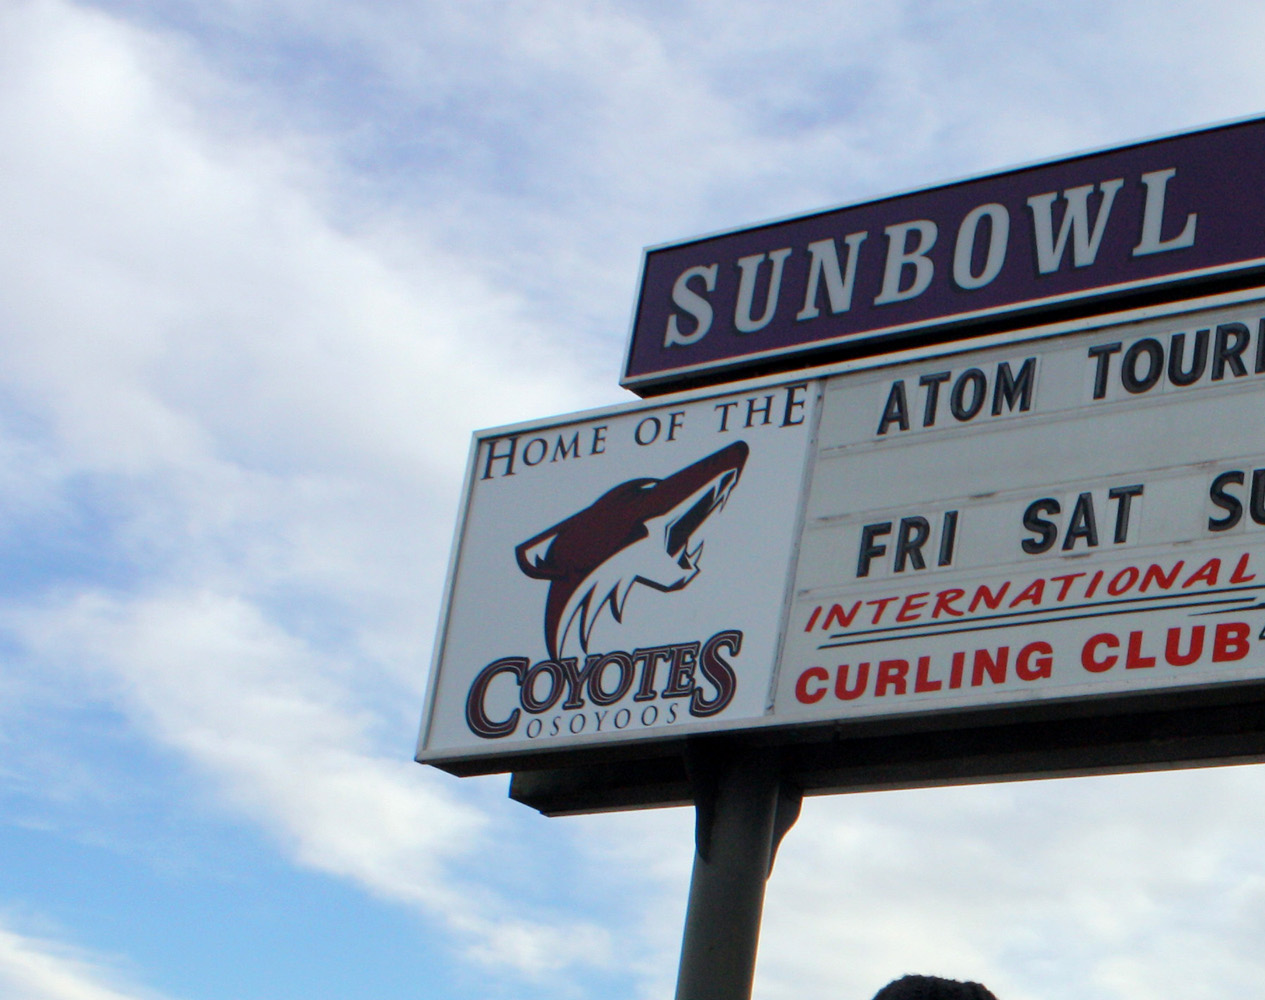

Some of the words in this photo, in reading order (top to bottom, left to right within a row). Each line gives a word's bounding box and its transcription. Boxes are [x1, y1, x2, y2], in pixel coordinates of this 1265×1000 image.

[663, 168, 1197, 348] SUNBOWL
[480, 426, 607, 480] HOME
[634, 412, 685, 446] OF
[714, 386, 808, 432] THE
[877, 357, 1037, 435] ATOM
[856, 511, 959, 577] FRI
[1021, 484, 1144, 554] SAT
[804, 552, 1256, 632] INTERNATIONAL
[465, 630, 743, 740] COYOTES
[795, 641, 1053, 704] CURLING
[1081, 622, 1250, 672] CLUB
[526, 703, 680, 740] OSOYOOS
